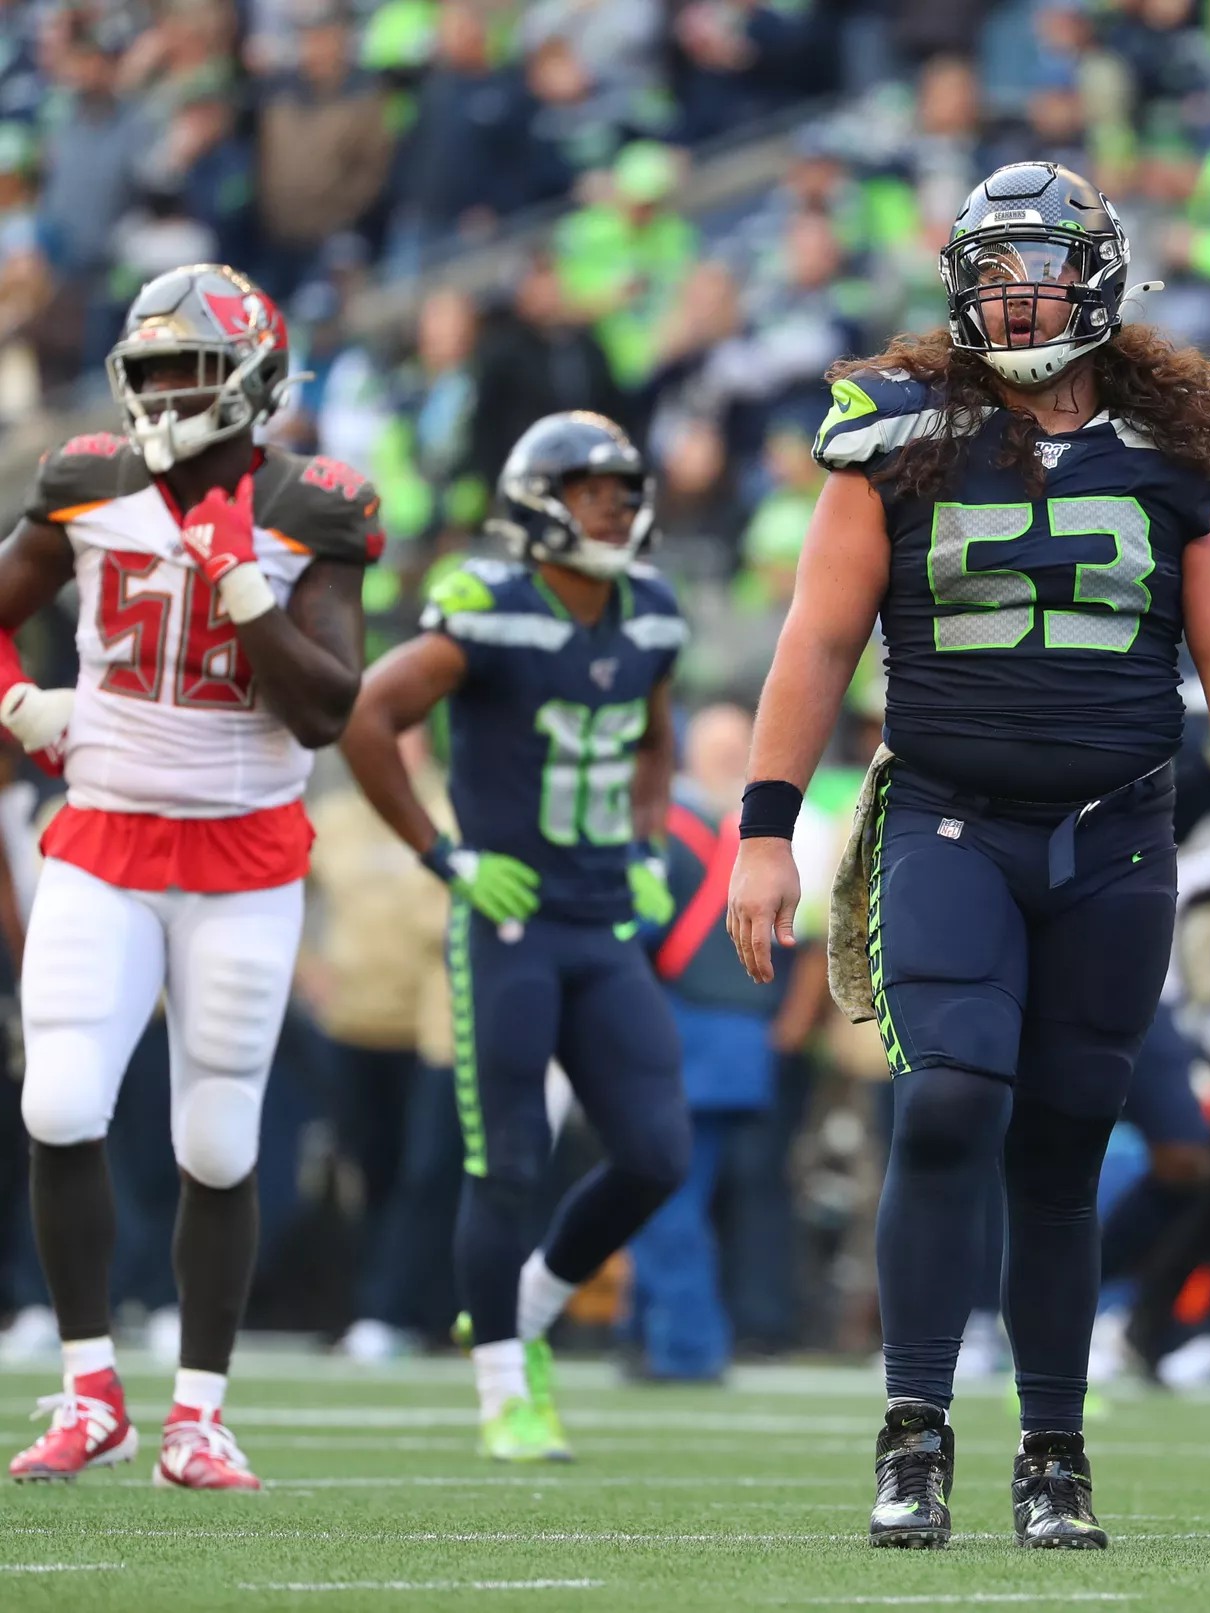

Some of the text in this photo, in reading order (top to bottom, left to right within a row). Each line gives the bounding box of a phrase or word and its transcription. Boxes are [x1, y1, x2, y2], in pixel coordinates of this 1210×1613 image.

[994, 211, 1026, 221] SEAHAWKS
[95, 549, 257, 711] 56
[927, 496, 1156, 653] 53
[535, 698, 648, 846] 16
